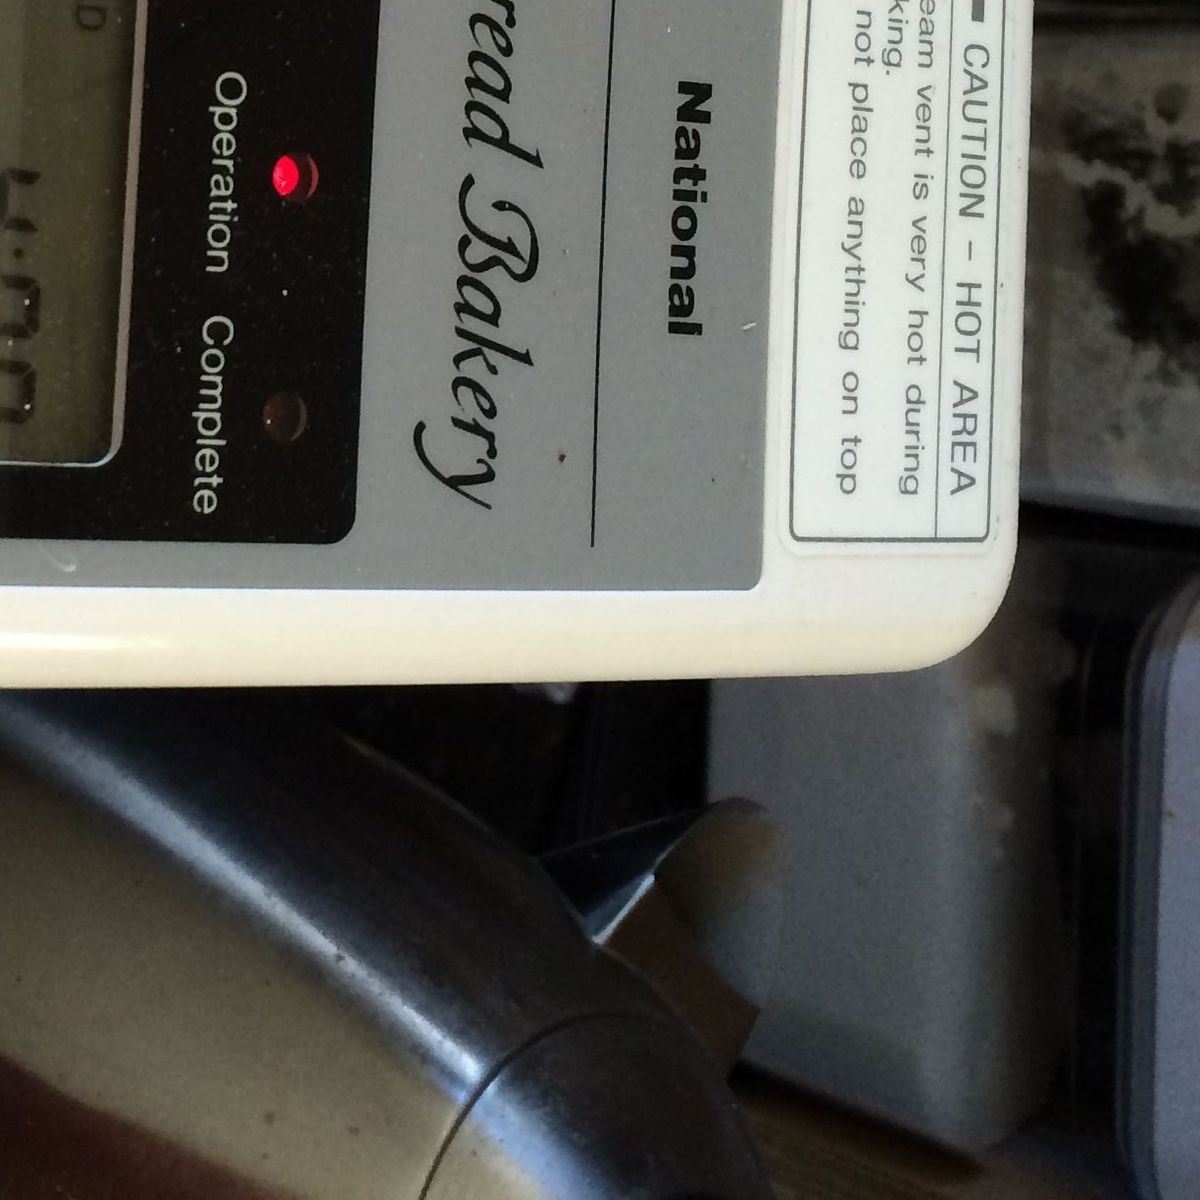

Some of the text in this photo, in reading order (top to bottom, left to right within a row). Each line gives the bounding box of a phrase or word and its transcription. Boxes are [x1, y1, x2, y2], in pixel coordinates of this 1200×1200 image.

[854, 9, 875, 68] not
[848, 81, 874, 180] place
[913, 84, 935, 158] vent
[958, 43, 990, 219] CAUTION
[205, 71, 247, 274] Operation
[668, 80, 713, 336] National
[912, 173, 935, 200] is
[838, 195, 866, 351] anything
[905, 215, 927, 293] very
[413, 173, 539, 510] Bakery
[907, 309, 929, 366] hot
[954, 281, 983, 363] HOT
[192, 314, 235, 516] Complete
[841, 370, 860, 415] on
[899, 383, 926, 496] during
[949, 379, 979, 496] AREA
[836, 434, 862, 496] top
